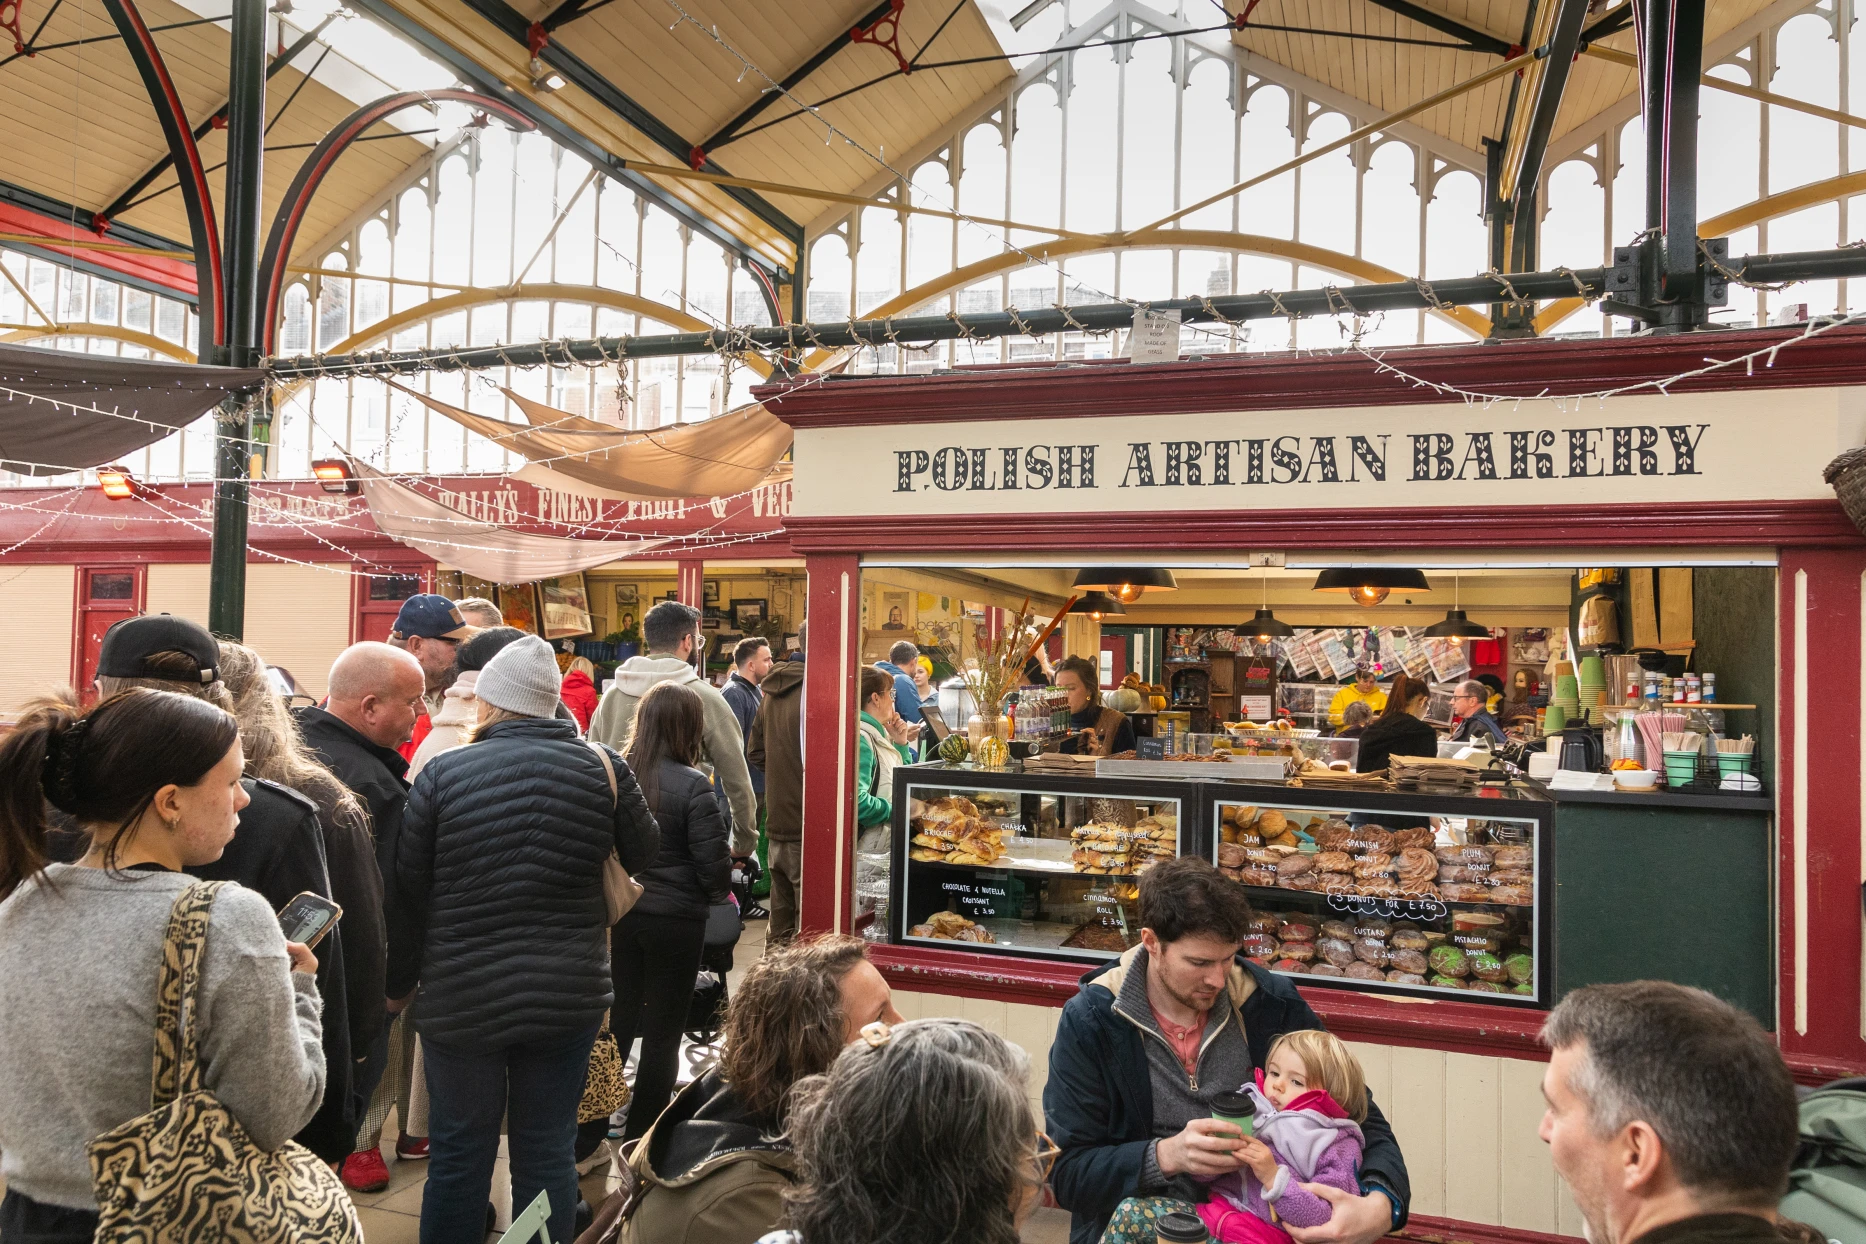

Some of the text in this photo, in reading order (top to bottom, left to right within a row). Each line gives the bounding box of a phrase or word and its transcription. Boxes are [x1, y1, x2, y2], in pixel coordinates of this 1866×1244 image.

[892, 424, 1711, 493] POLISH ARTISAN BAKERY
[1243, 834, 1260, 845] JAM
[1346, 838, 1379, 850] SPANISH
[1246, 849, 1265, 857] DONUT
[1462, 848, 1481, 859] PLUM
[1354, 854, 1378, 864] DONUT
[1467, 863, 1491, 871] DONUT
[981, 886, 1006, 896] NUTELLA
[1336, 894, 1344, 902] 3
[1347, 895, 1376, 906] DONUTS
[1385, 899, 1400, 910] FOR
[1419, 901, 1437, 911] 7.50
[1353, 926, 1386, 937] CUSTARD
[1454, 935, 1487, 945] PISTACHIO
